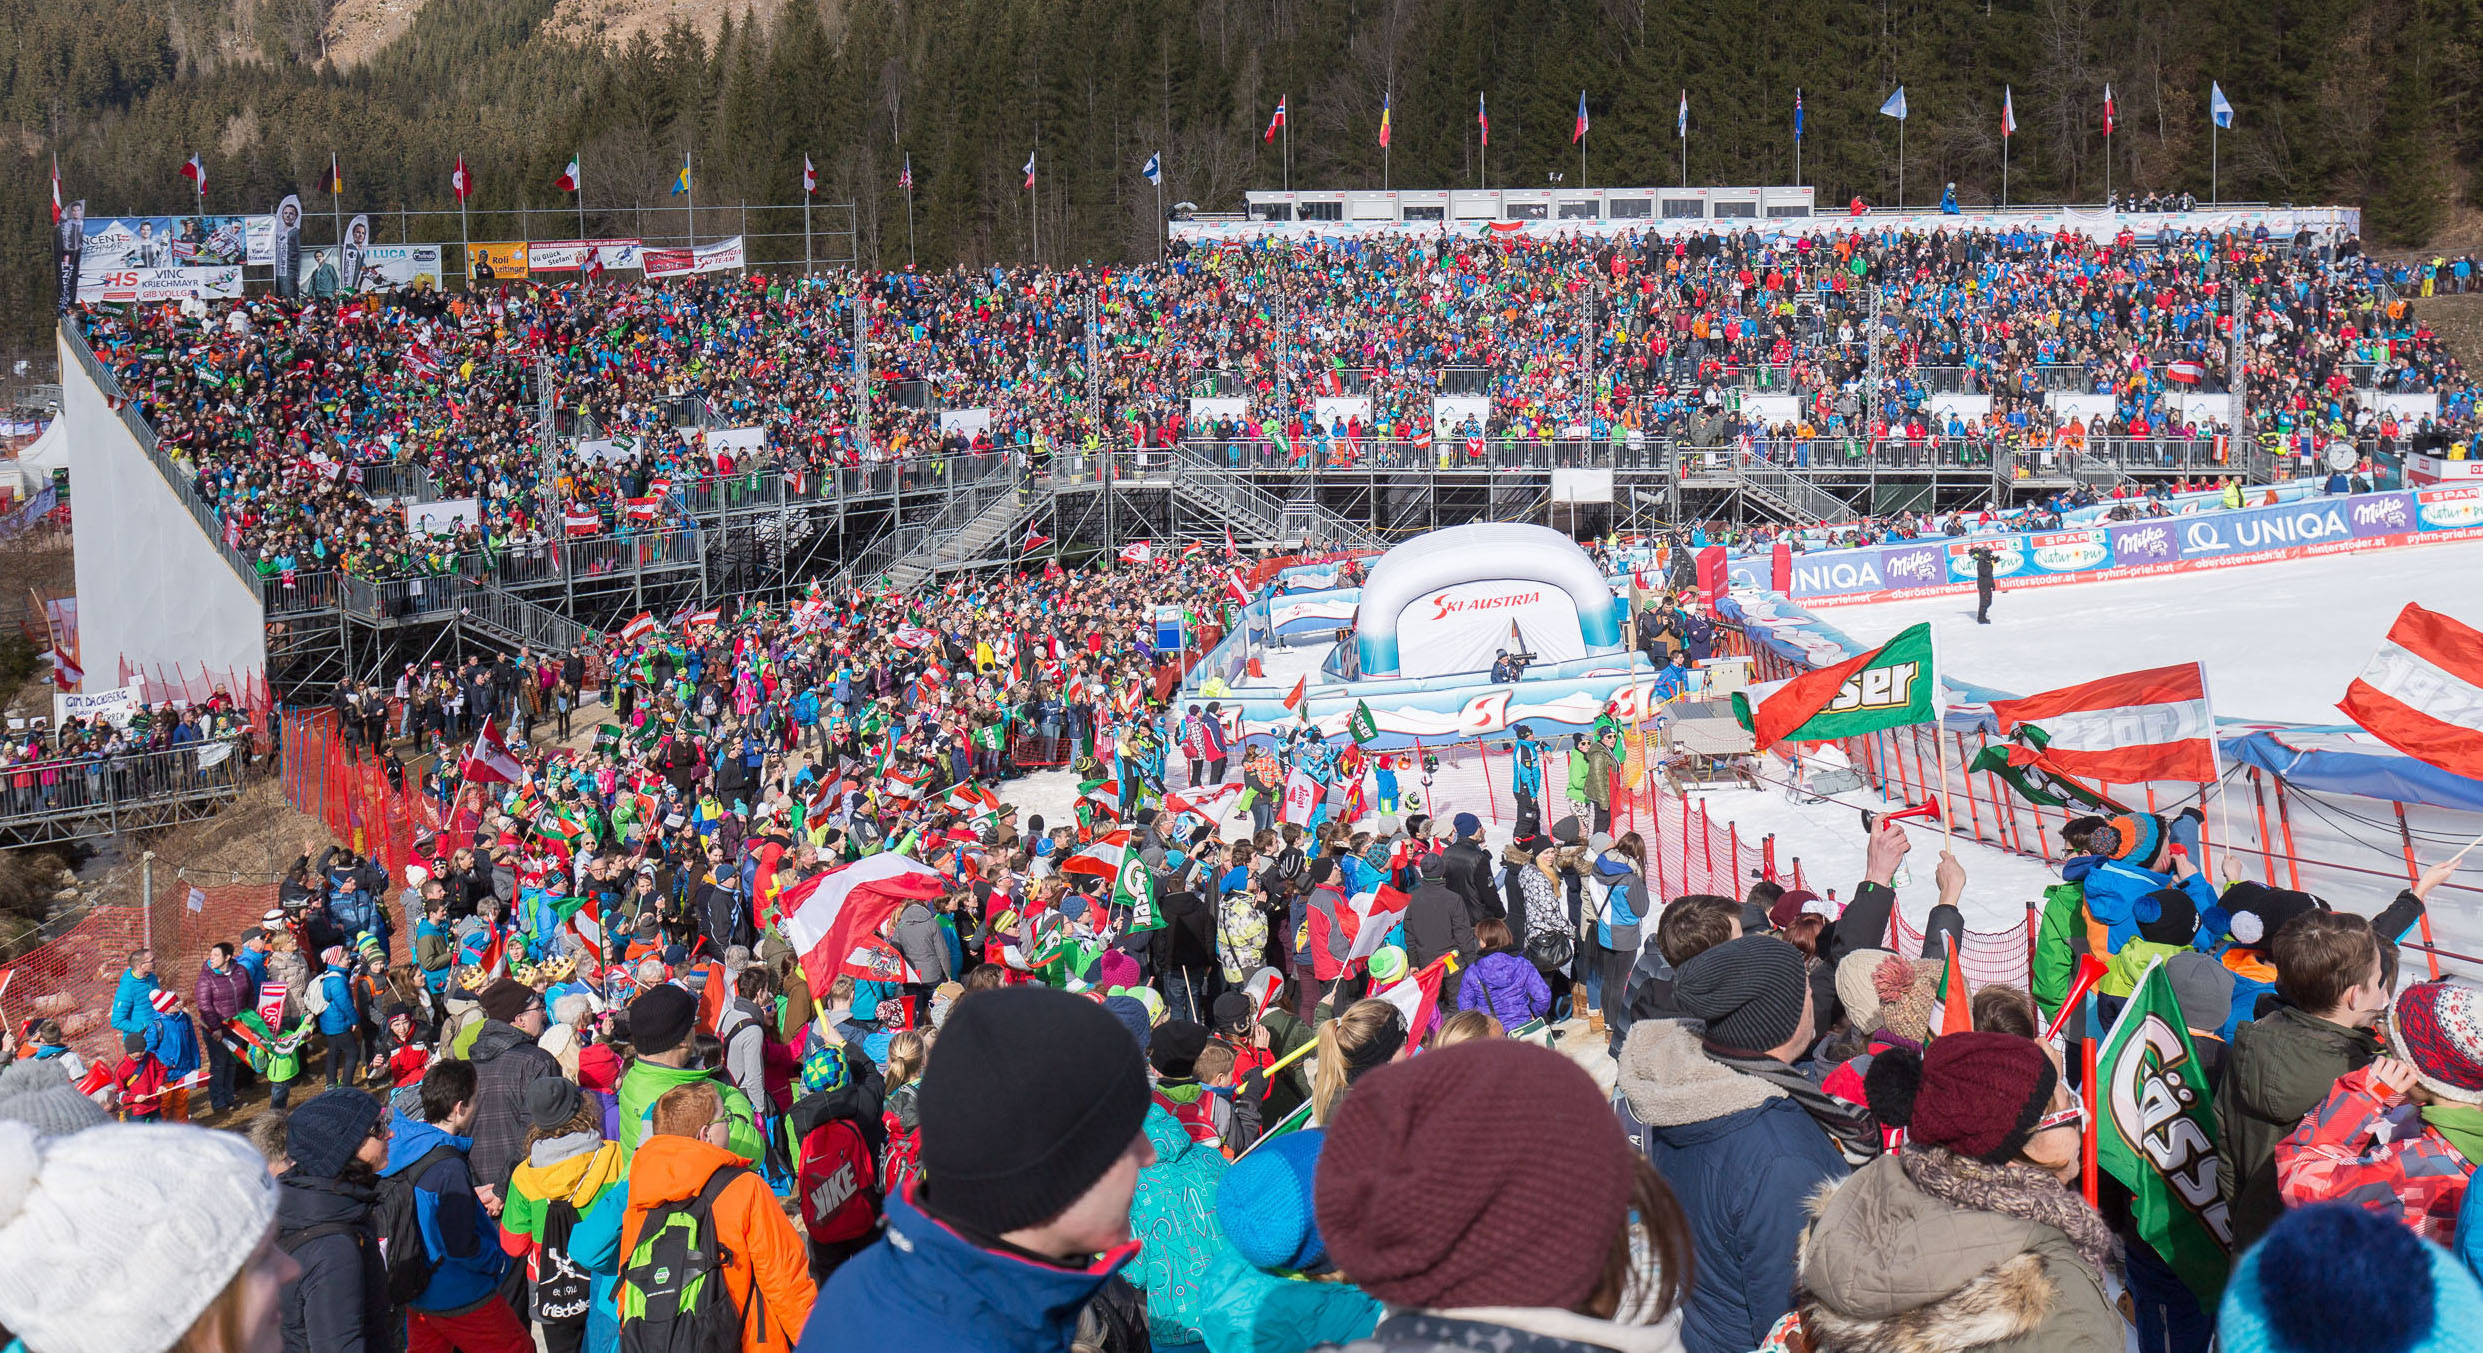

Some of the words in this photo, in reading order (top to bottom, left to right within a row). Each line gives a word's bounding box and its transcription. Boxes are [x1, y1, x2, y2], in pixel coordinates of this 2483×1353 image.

[374, 249, 407, 259] LUCA
[492, 255, 509, 264] Roli
[142, 279, 199, 288] KRIECHMAYR
[154, 269, 184, 279] VINC
[142, 290, 157, 298] GIB
[159, 289, 192, 298] VOLLGA
[2432, 488, 2479, 501] SPAR
[2354, 497, 2404, 525] Milka
[2236, 510, 2348, 546] UNIQA
[2045, 534, 2089, 545] SPAR
[2117, 527, 2166, 554] Milka
[1887, 551, 1935, 577] Milka
[2000, 574, 2076, 588] hinterstoder.at
[2097, 563, 2174, 580] pyhrn-priel.net
[2195, 549, 2287, 568] oberösterreich.at
[2307, 537, 2386, 555] hinterstoder.at
[2407, 527, 2483, 545] pyhrn-priel.ne
[2037, 547, 2071, 565] Natur
[2083, 546, 2106, 561] pur
[1467, 592, 1540, 611] AUSTRIA
[810, 1160, 858, 1221] NIKE
